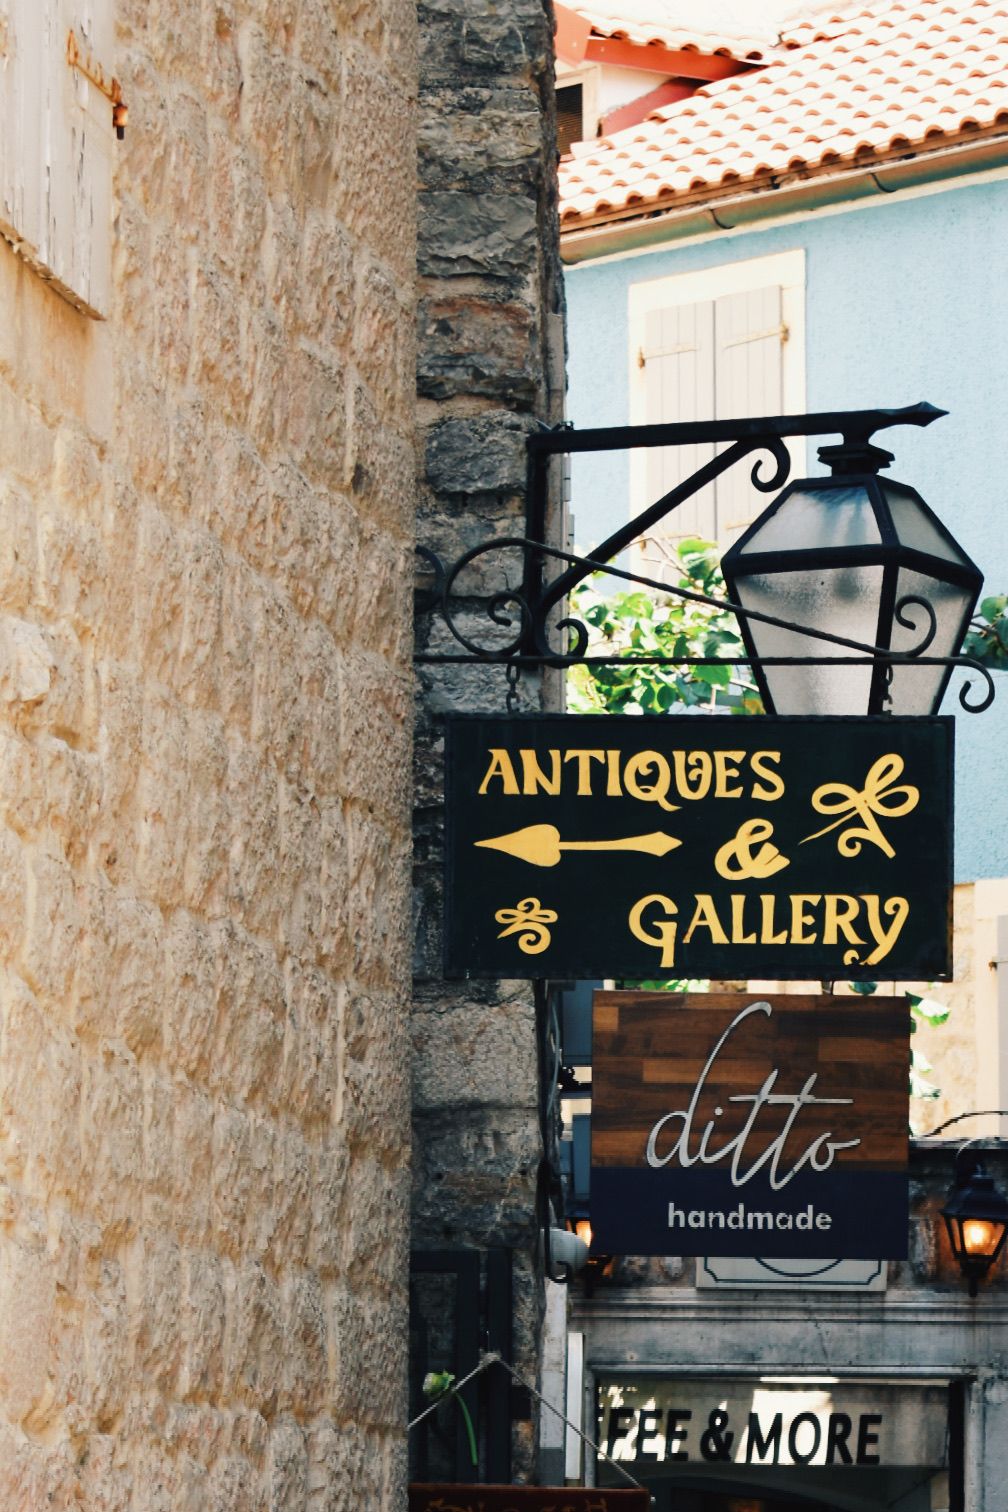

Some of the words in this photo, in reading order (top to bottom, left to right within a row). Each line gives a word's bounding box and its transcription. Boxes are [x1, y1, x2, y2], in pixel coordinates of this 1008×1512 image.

[477, 748, 786, 812] ANTIQUES
[714, 818, 790, 880] &
[628, 893, 910, 968] GALLERY
[646, 1001, 861, 1190] ditto
[667, 1202, 832, 1231] handmade
[699, 1408, 734, 1462] &
[746, 1412, 883, 1465] MORE
